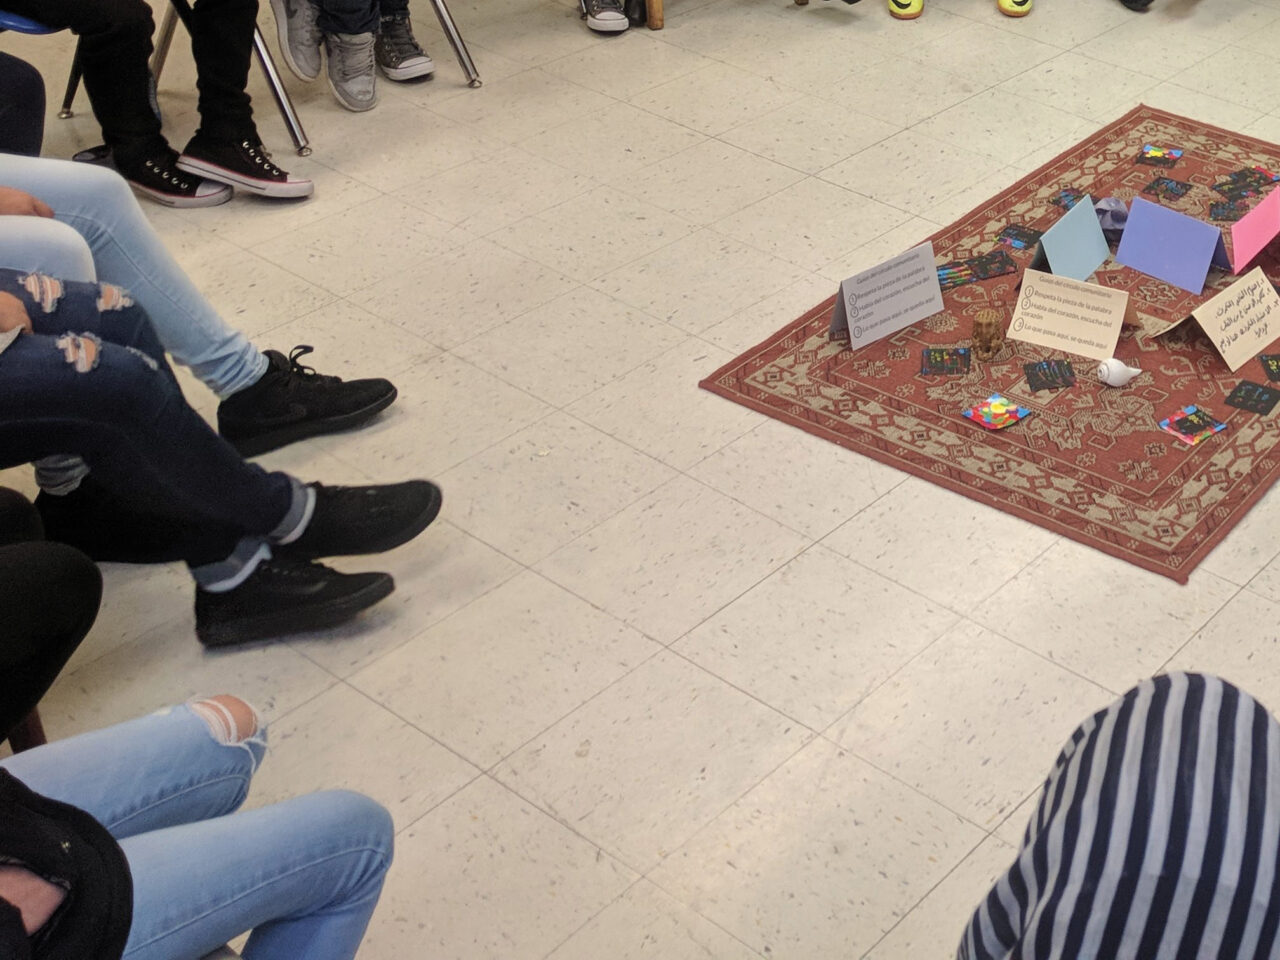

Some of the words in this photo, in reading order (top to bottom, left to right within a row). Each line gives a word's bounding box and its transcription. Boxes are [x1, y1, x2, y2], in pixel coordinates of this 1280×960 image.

[1029, 302, 1047, 311] Habla
[1080, 316, 1102, 325] escucha
[1034, 292, 1056, 301] Respeta
[1090, 306, 1112, 315] palabra
